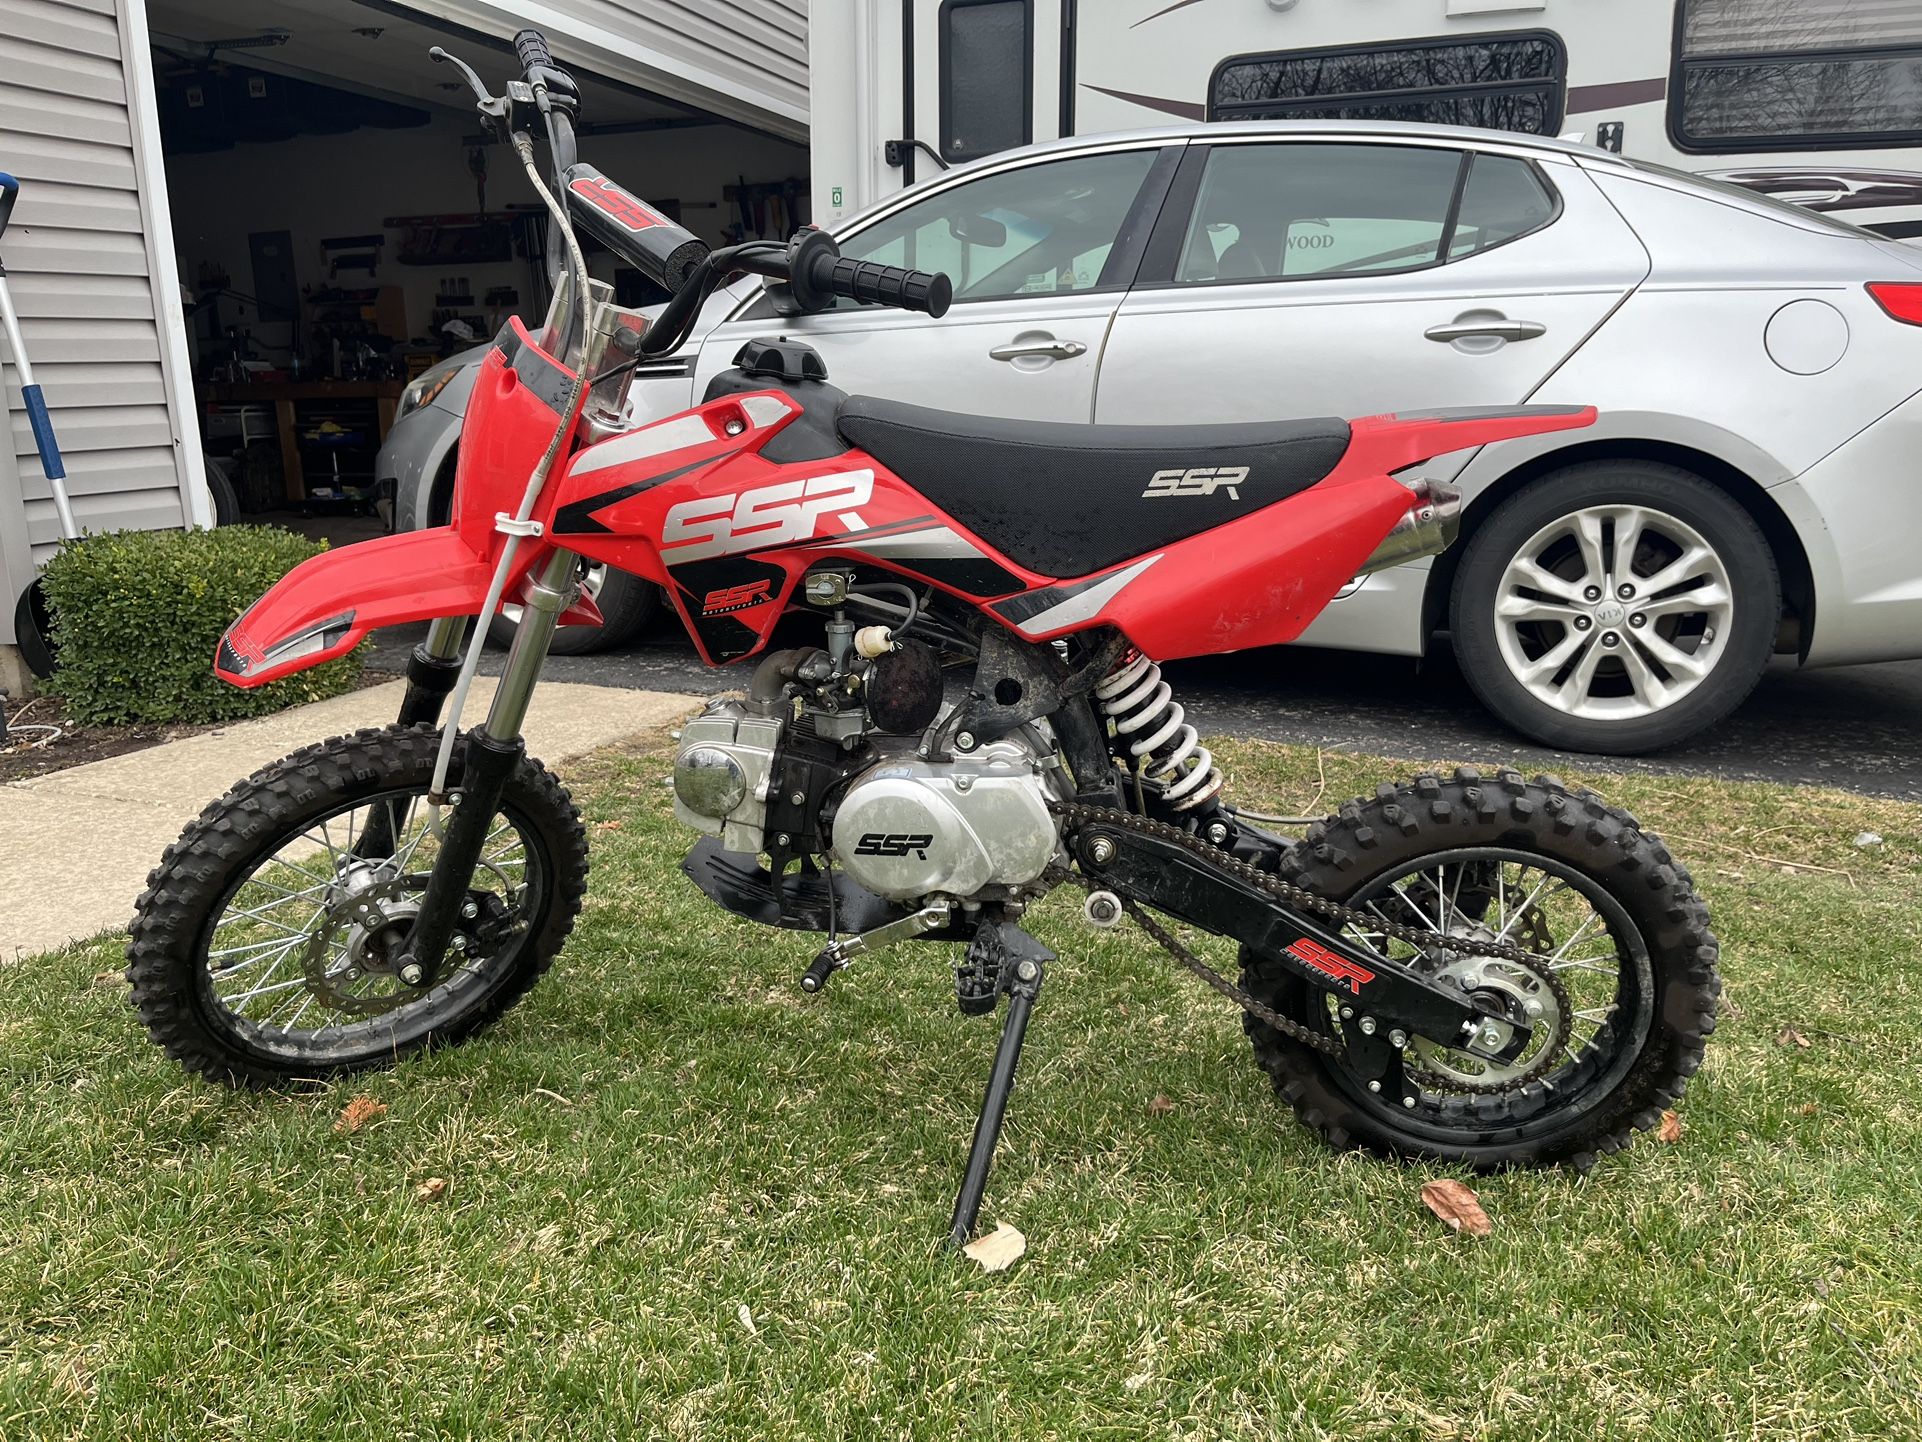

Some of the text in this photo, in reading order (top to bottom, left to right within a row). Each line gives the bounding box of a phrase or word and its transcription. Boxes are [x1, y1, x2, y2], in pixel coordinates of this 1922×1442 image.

[1141, 466, 1250, 500] SSR
[659, 468, 875, 567] SSR
[703, 579, 773, 611] SSR
[1598, 608, 1622, 620] KIA
[854, 833, 934, 861] SSR
[1286, 937, 1376, 995] SSR
